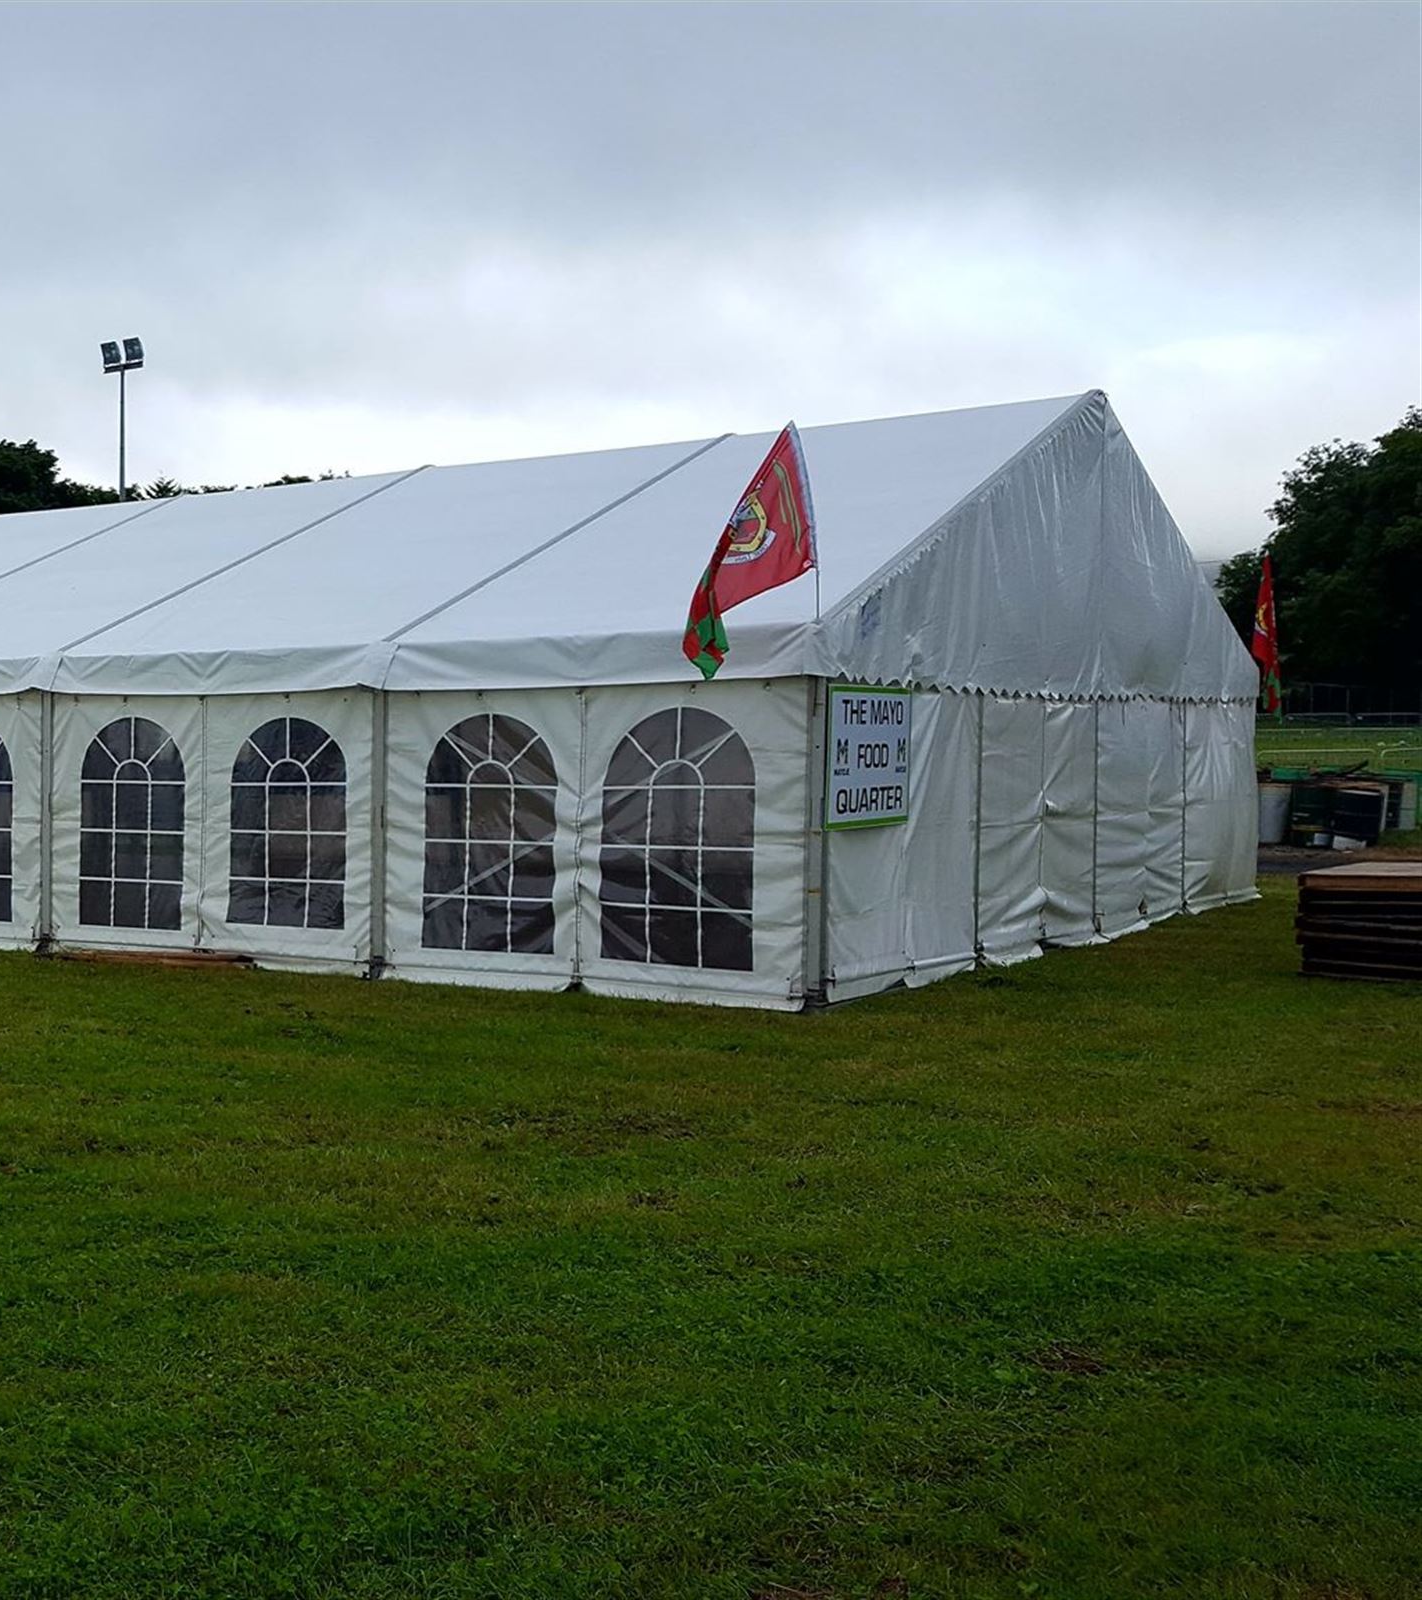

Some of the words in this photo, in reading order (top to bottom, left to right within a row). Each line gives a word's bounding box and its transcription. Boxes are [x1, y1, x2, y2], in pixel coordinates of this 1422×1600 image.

[842, 699, 867, 725] THE
[870, 700, 904, 726] MAYO
[857, 743, 890, 769] FOOD
[836, 785, 903, 815] QUARTER
